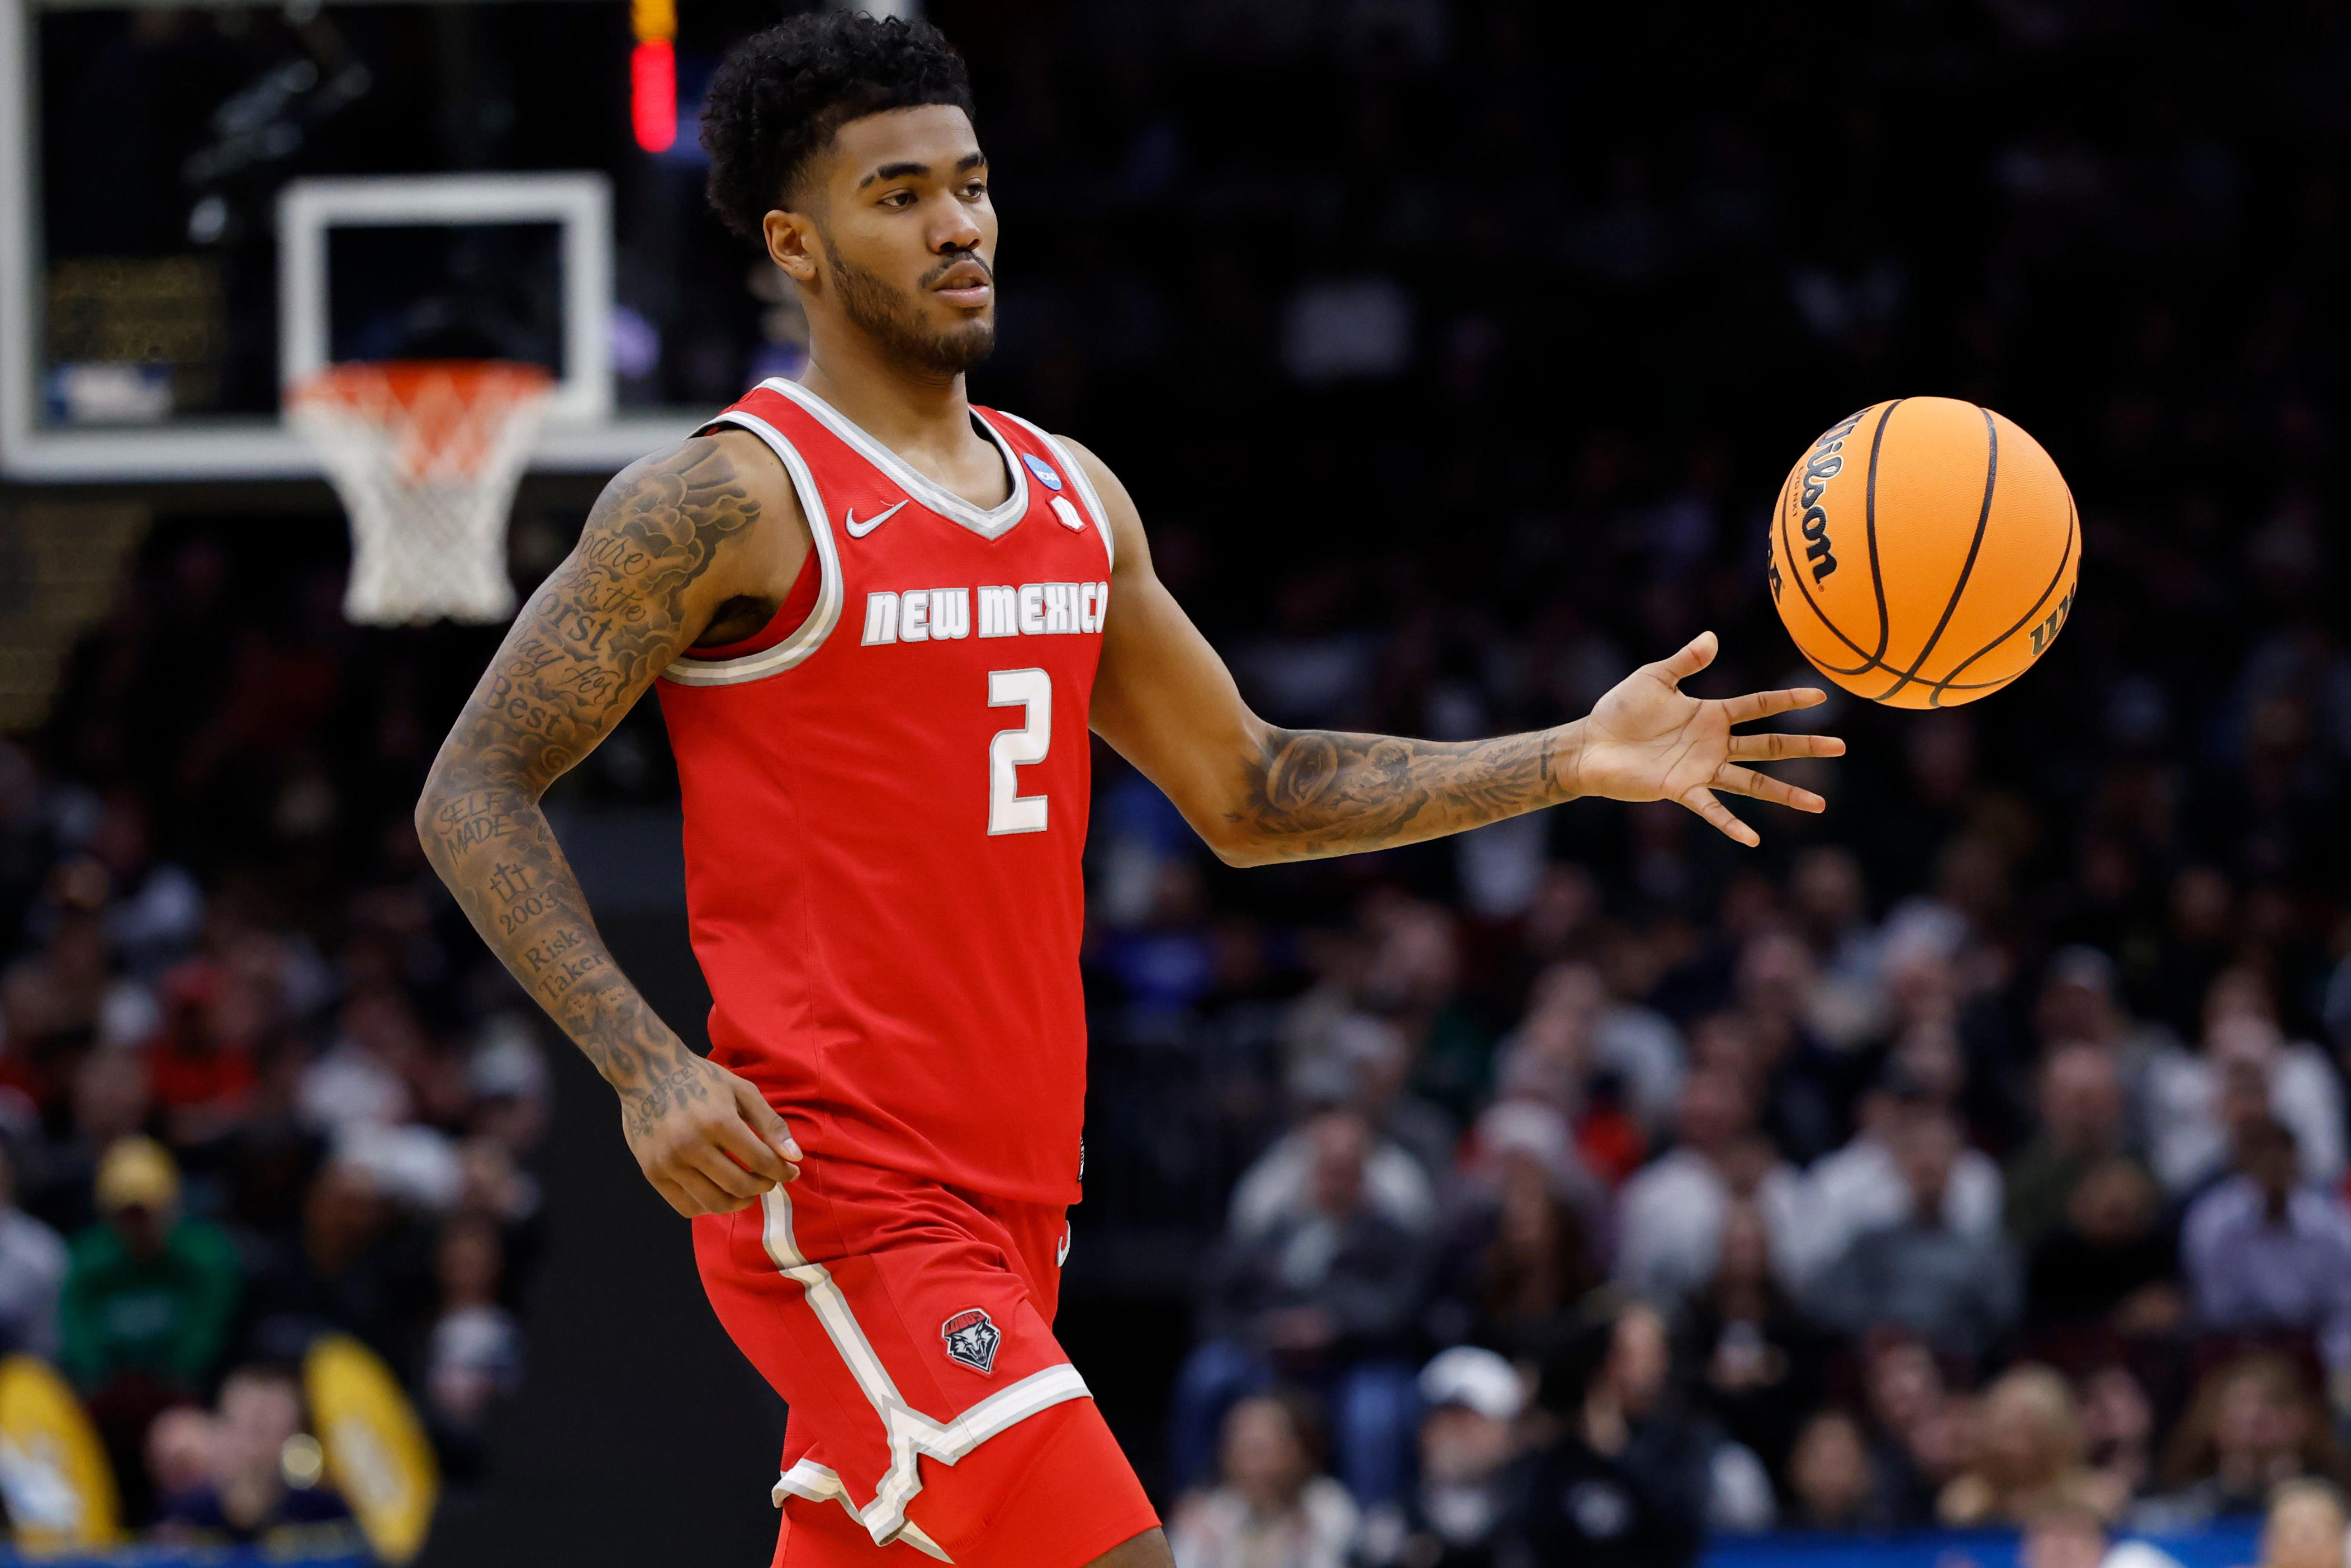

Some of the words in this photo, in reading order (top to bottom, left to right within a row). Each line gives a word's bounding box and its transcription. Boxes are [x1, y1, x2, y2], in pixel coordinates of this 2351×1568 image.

[1801, 406, 1875, 585] Wilson
[535, 593, 612, 651] orst
[861, 588, 970, 647] NEW
[977, 581, 1108, 638] MEXICO
[987, 667, 1051, 836] 2
[440, 791, 507, 835] SELF
[448, 813, 518, 868] MADE
[500, 892, 559, 935] 2003
[524, 929, 580, 972] Risk
[539, 953, 604, 999] Taker
[945, 1311, 986, 1336] LOBOS
